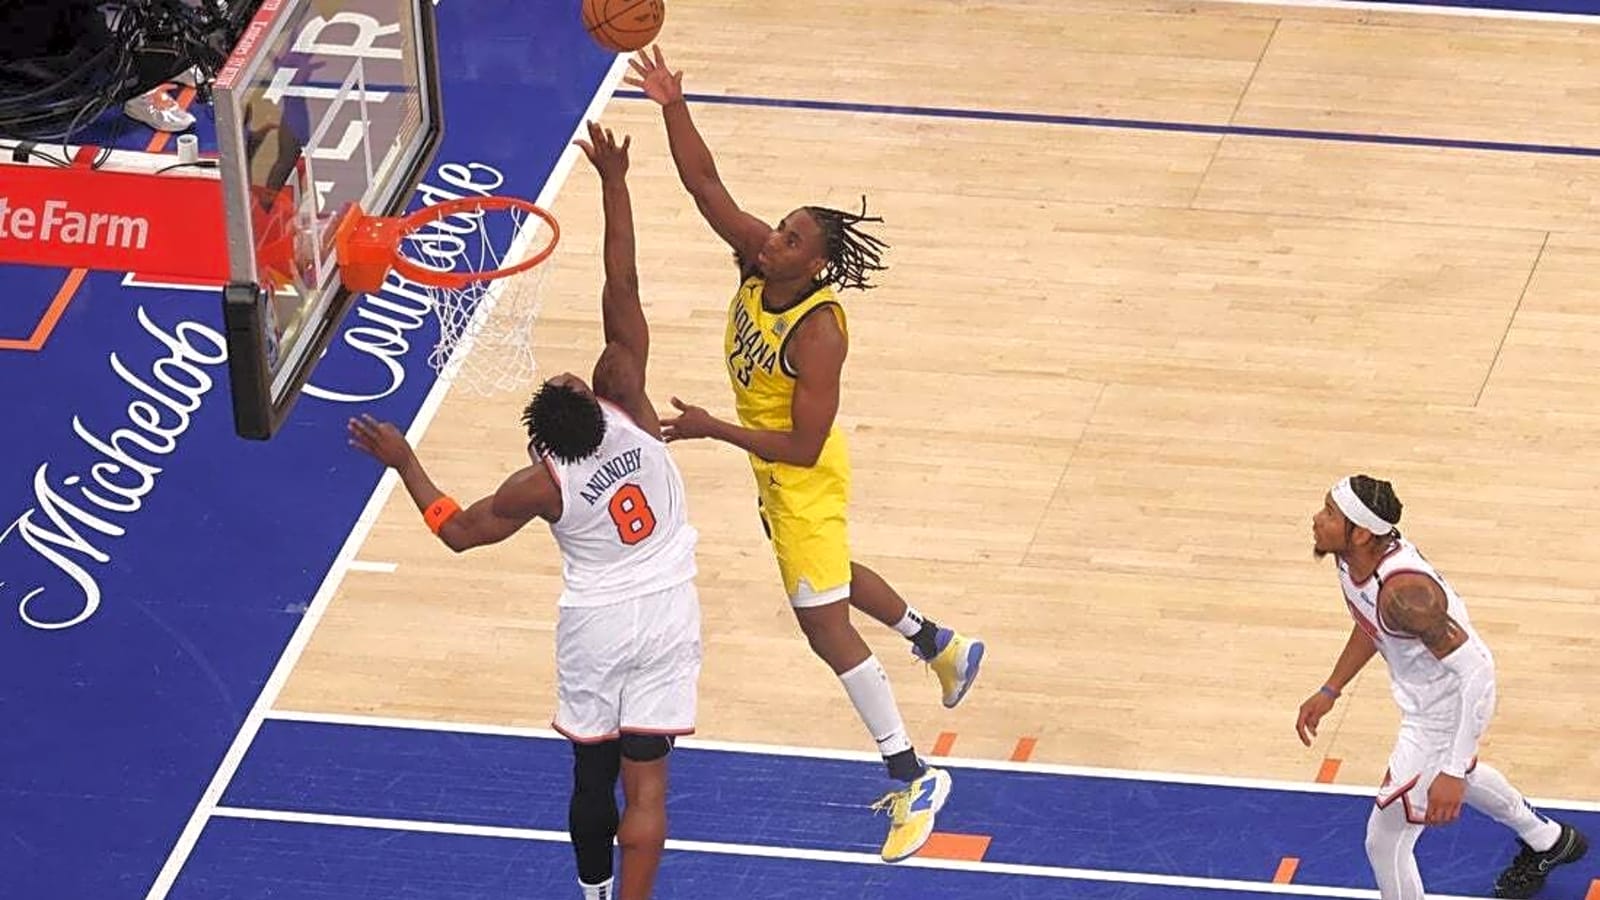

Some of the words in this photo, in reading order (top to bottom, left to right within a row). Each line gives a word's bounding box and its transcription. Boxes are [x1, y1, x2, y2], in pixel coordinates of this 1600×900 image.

[729, 333, 755, 388] 23
[0, 305, 228, 630] Michelob
[579, 447, 642, 506] ANUNOBY
[608, 482, 657, 546] 8
